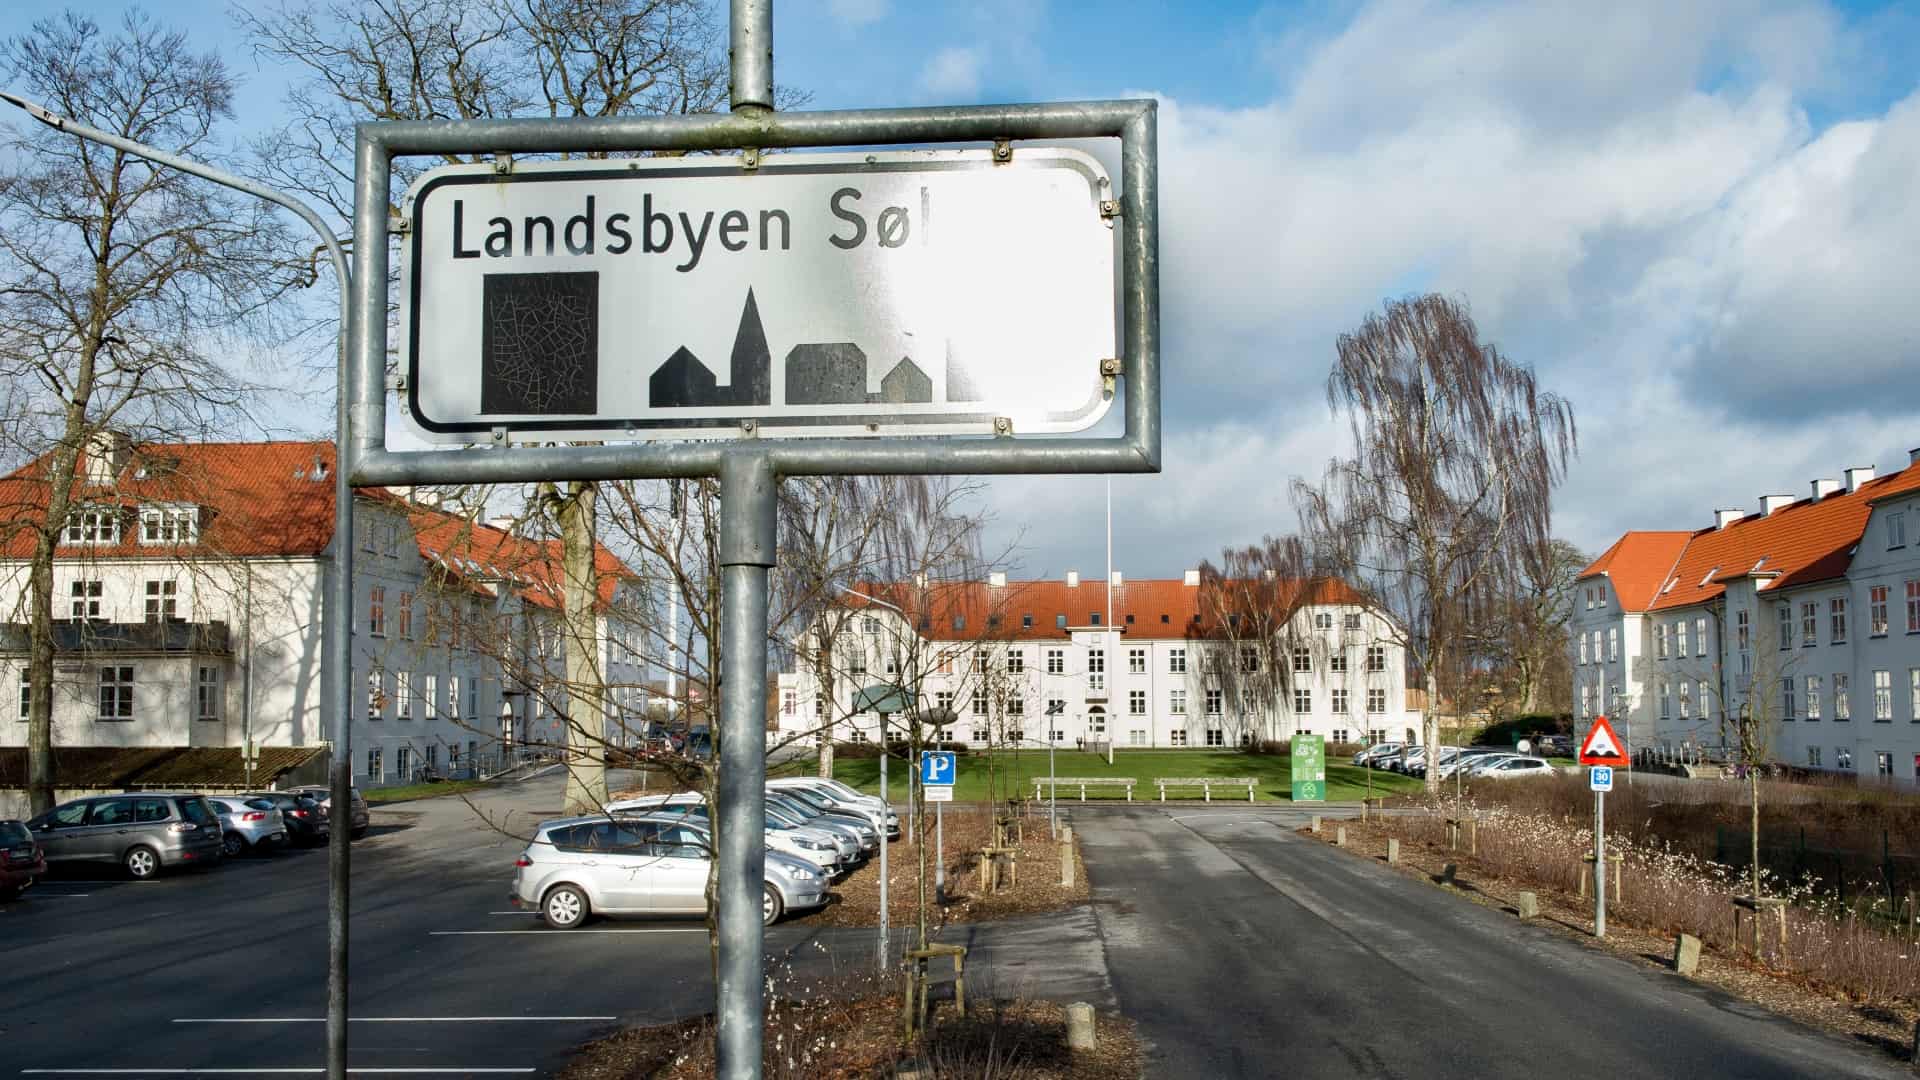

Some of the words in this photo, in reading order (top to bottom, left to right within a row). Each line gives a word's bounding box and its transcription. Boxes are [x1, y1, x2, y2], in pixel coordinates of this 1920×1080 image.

[453, 193, 790, 273] Landsbyen
[928, 756, 949, 780] P
[1596, 772, 1608, 782] 30
